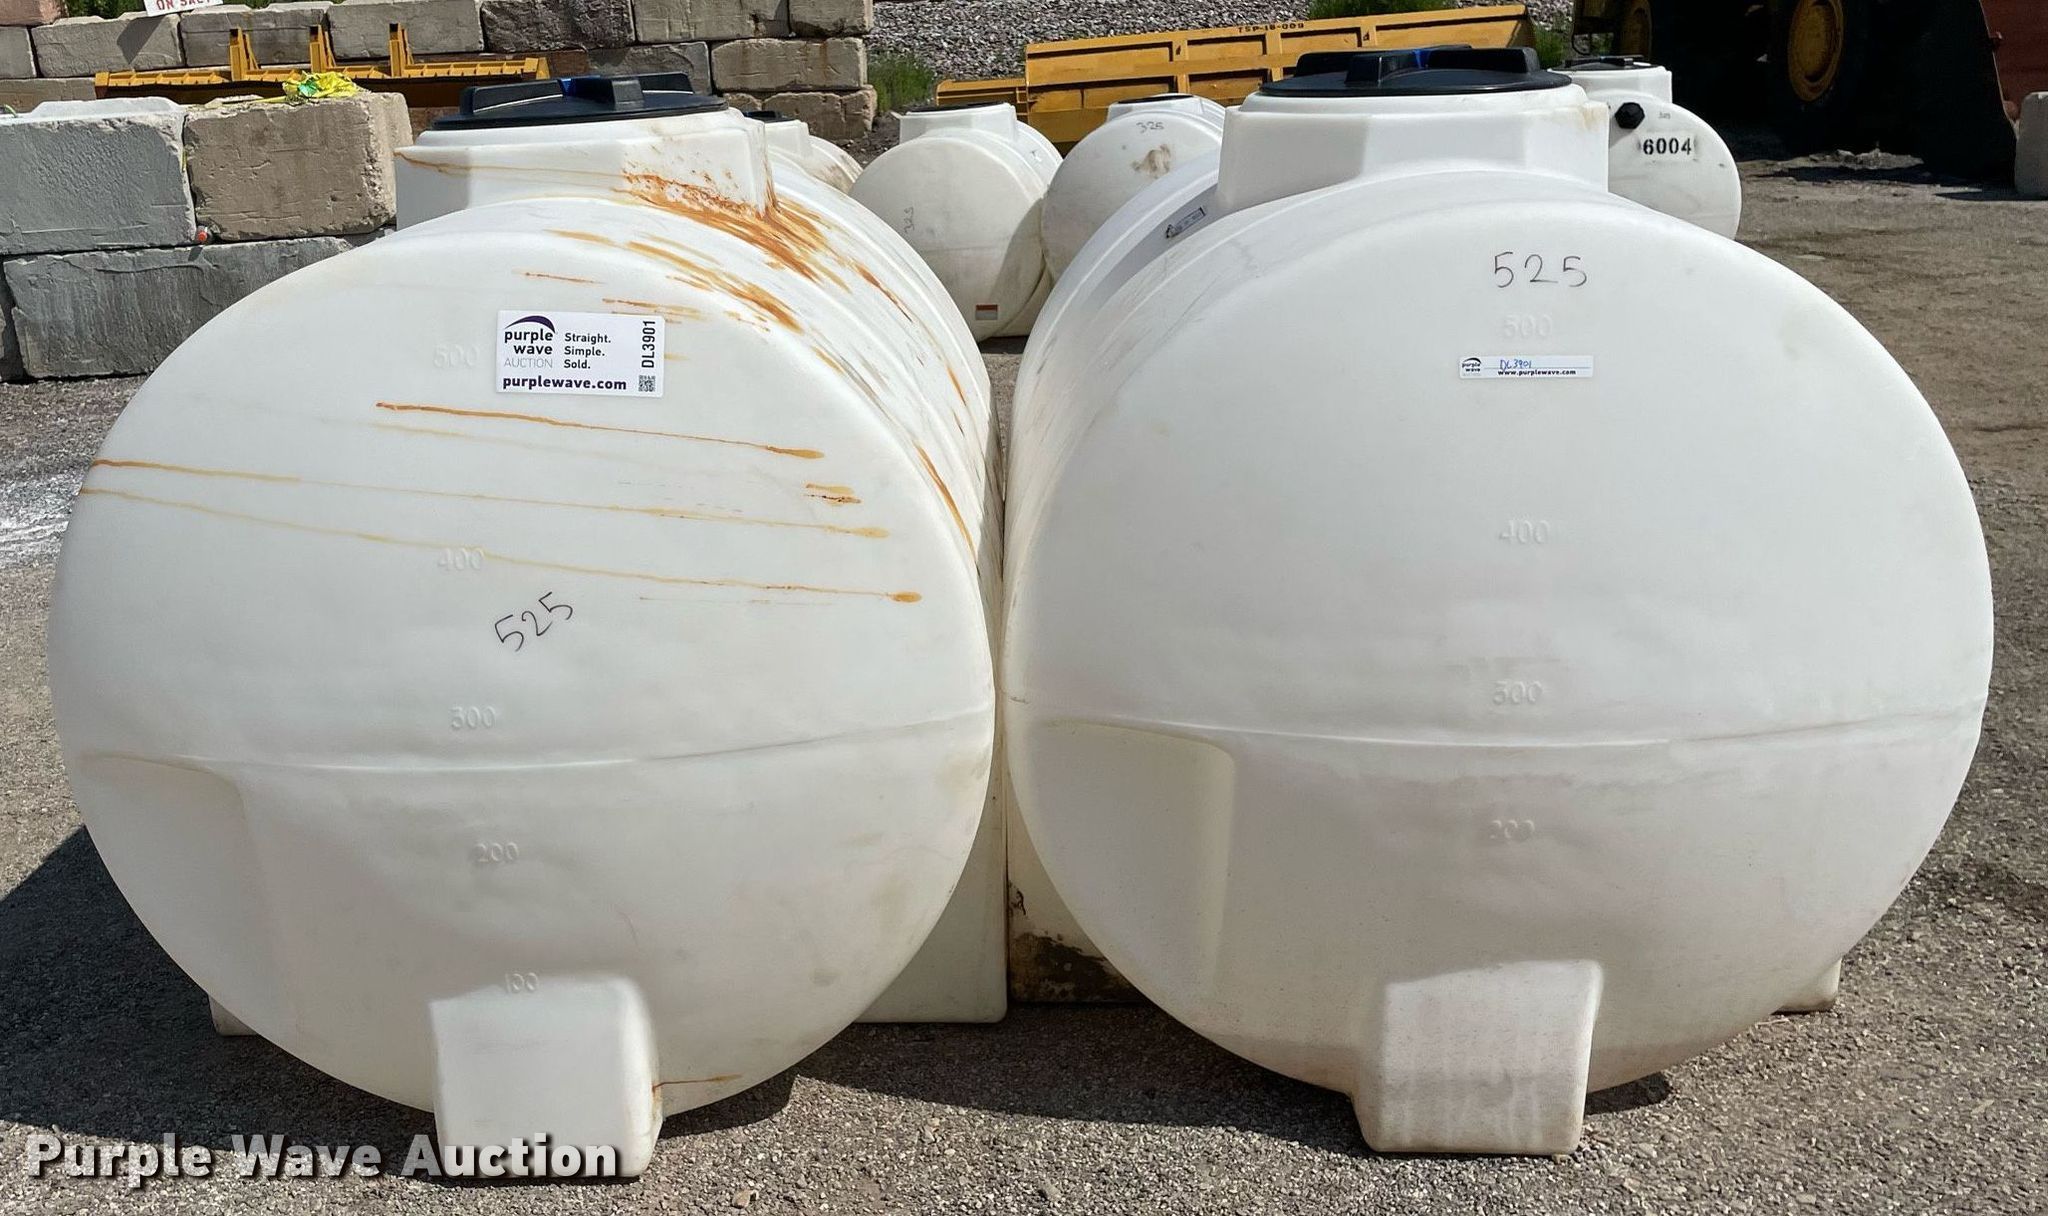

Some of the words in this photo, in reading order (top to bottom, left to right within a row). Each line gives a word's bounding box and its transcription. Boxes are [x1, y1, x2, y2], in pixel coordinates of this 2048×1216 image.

[1643, 138, 1691, 155] 6004
[1494, 251, 1587, 288] 525
[504, 328, 553, 343] purple
[565, 333, 611, 345] Straight.
[641, 320, 656, 368] DL3901
[513, 345, 552, 354] wave
[564, 346, 605, 357] Simple.
[504, 358, 553, 368] AUCTION
[564, 360, 591, 369] Sold.
[502, 375, 627, 390] purplewave.com
[1499, 519, 1550, 544] 400
[437, 547, 484, 571] 400
[494, 591, 573, 652] 525
[1492, 680, 1543, 705] 300
[450, 706, 496, 730] 300
[476, 841, 519, 863] 200
